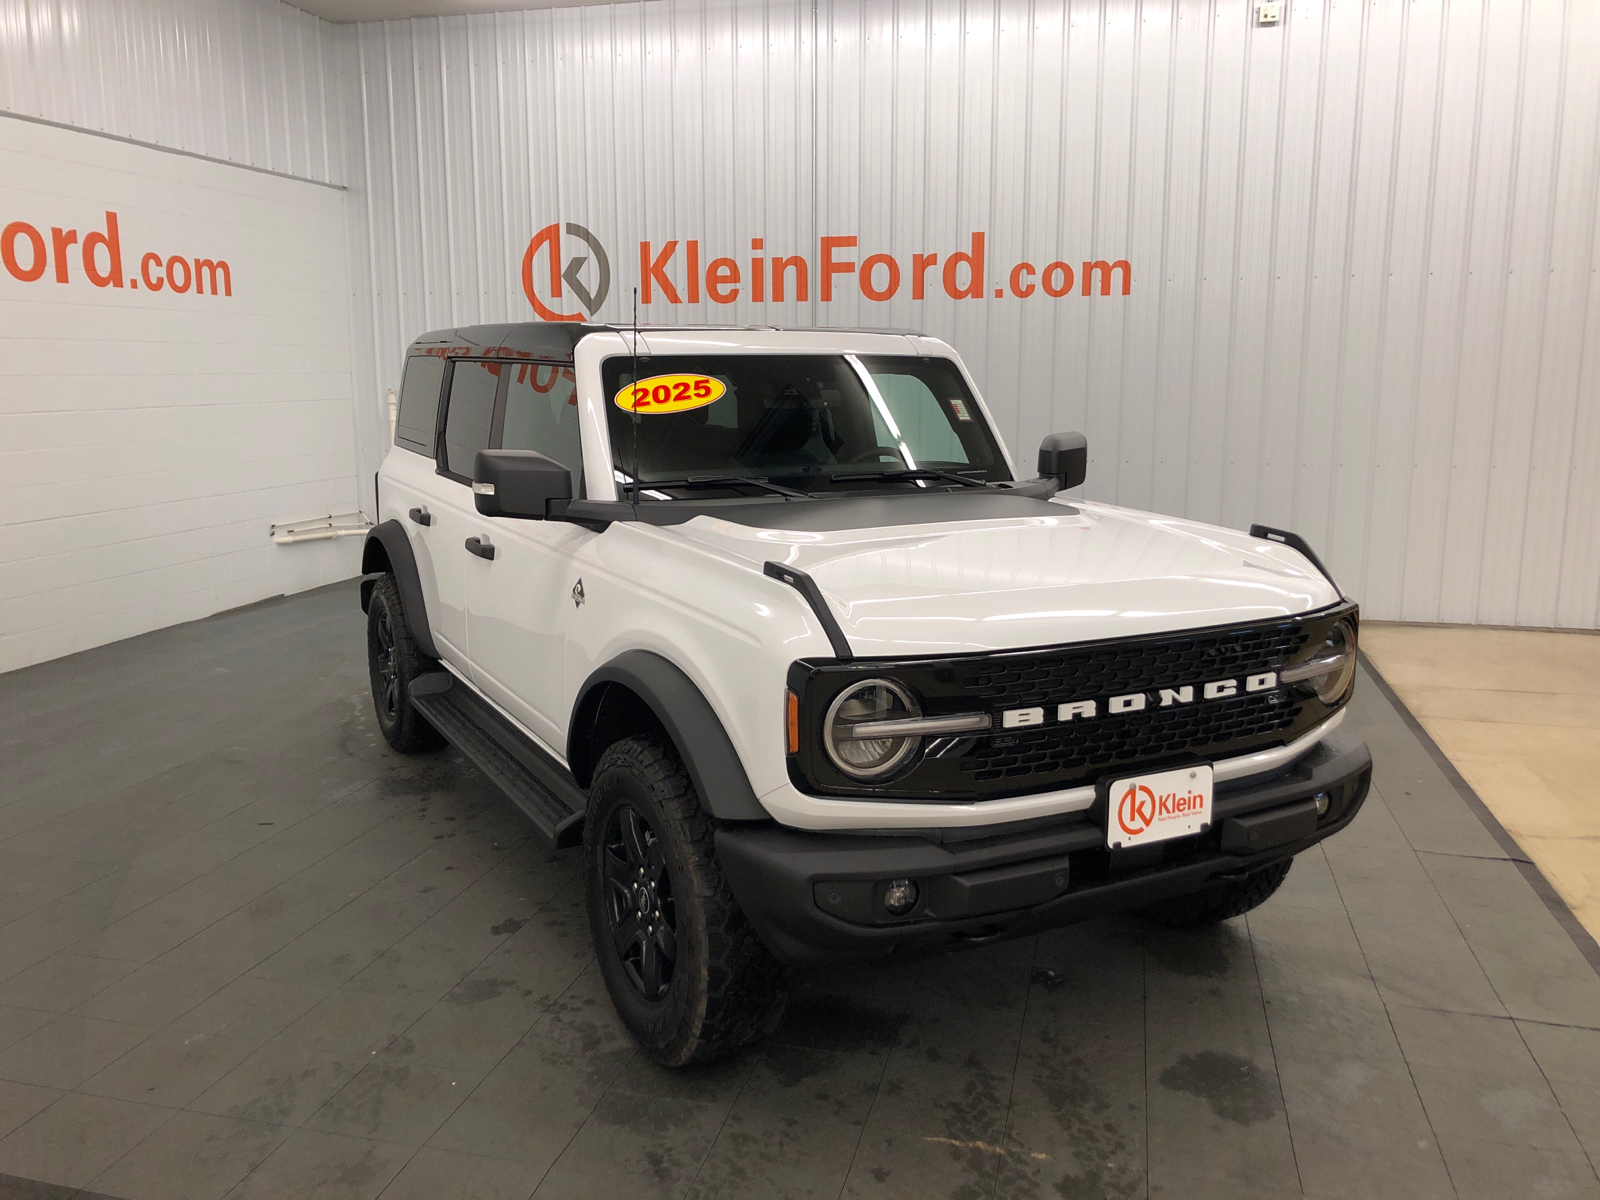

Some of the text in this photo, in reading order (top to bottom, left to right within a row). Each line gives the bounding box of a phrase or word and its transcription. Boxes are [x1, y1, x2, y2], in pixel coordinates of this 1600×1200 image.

[0, 211, 232, 297] ord.com
[640, 232, 1132, 304] KleinFord.com
[631, 379, 712, 408] 2025
[1003, 672, 1278, 728] BRONCO
[1158, 790, 1203, 816] Klein
